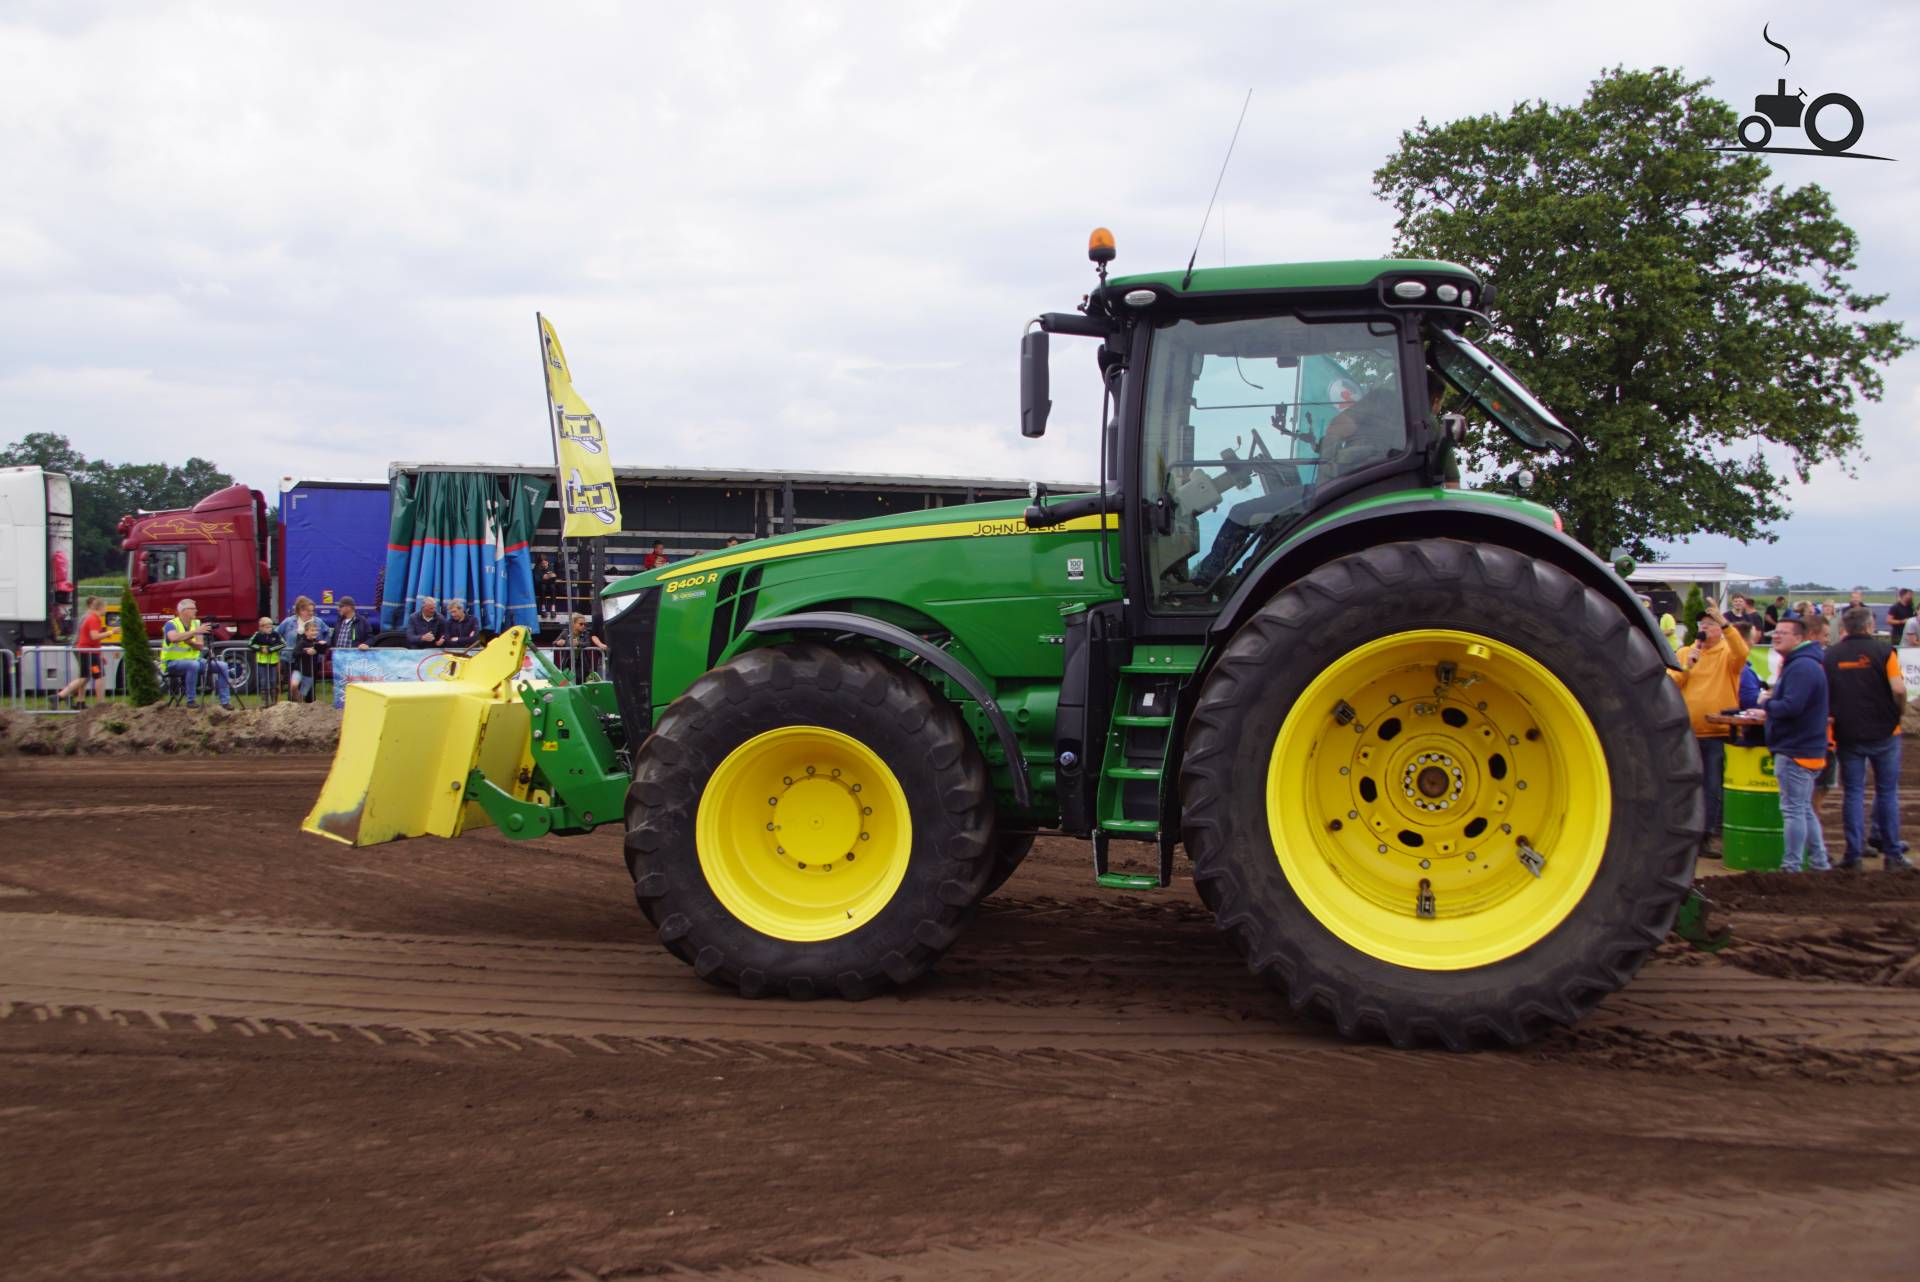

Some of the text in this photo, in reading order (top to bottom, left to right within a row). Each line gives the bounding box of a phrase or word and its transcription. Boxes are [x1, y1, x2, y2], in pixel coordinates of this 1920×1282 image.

[974, 523, 1014, 535] JOHN
[667, 573, 718, 593] 8400 R
